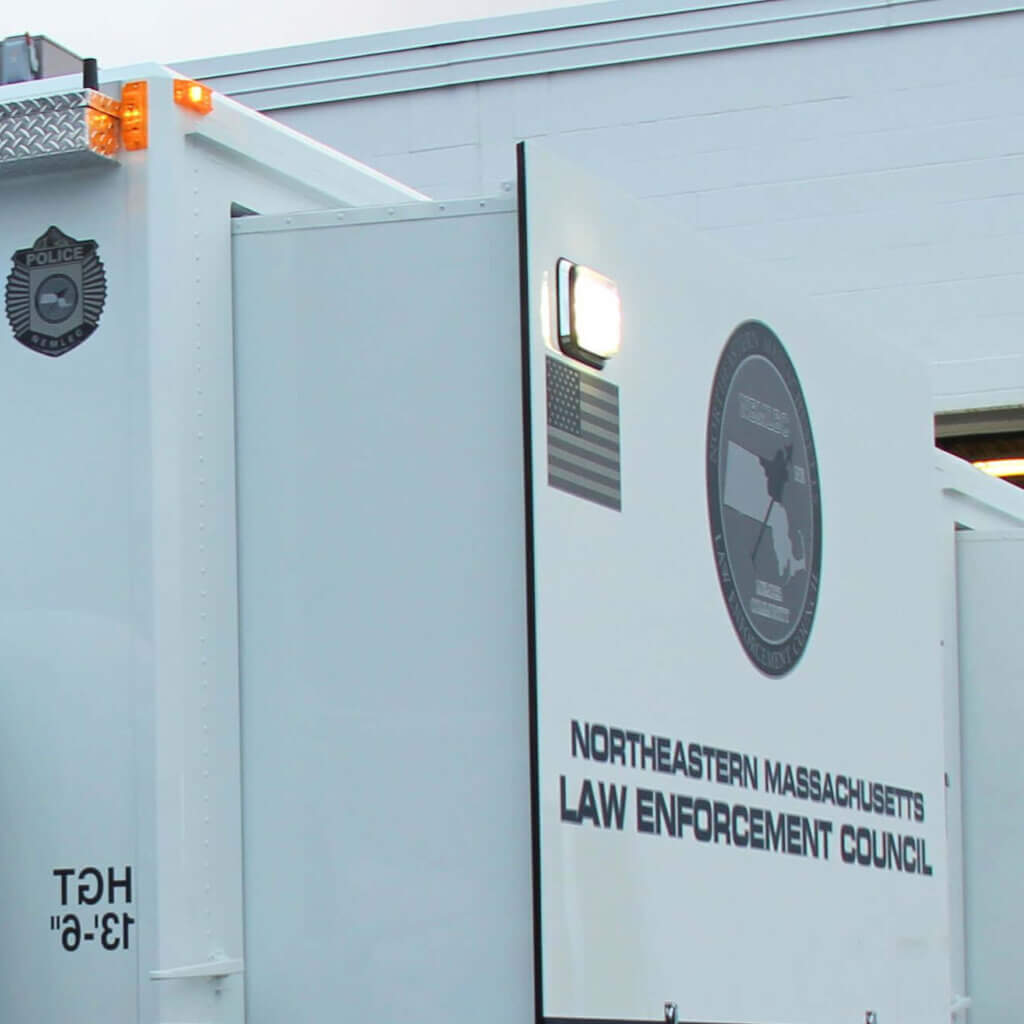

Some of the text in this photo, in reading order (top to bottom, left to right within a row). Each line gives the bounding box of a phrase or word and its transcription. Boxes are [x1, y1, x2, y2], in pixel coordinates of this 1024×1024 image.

[25, 245, 84, 266] POLICE
[570, 719, 926, 823] NORTHEASTERN MASSACHUSETTS
[559, 774, 934, 877] LAW ENFORCEMENT COUNCIL
